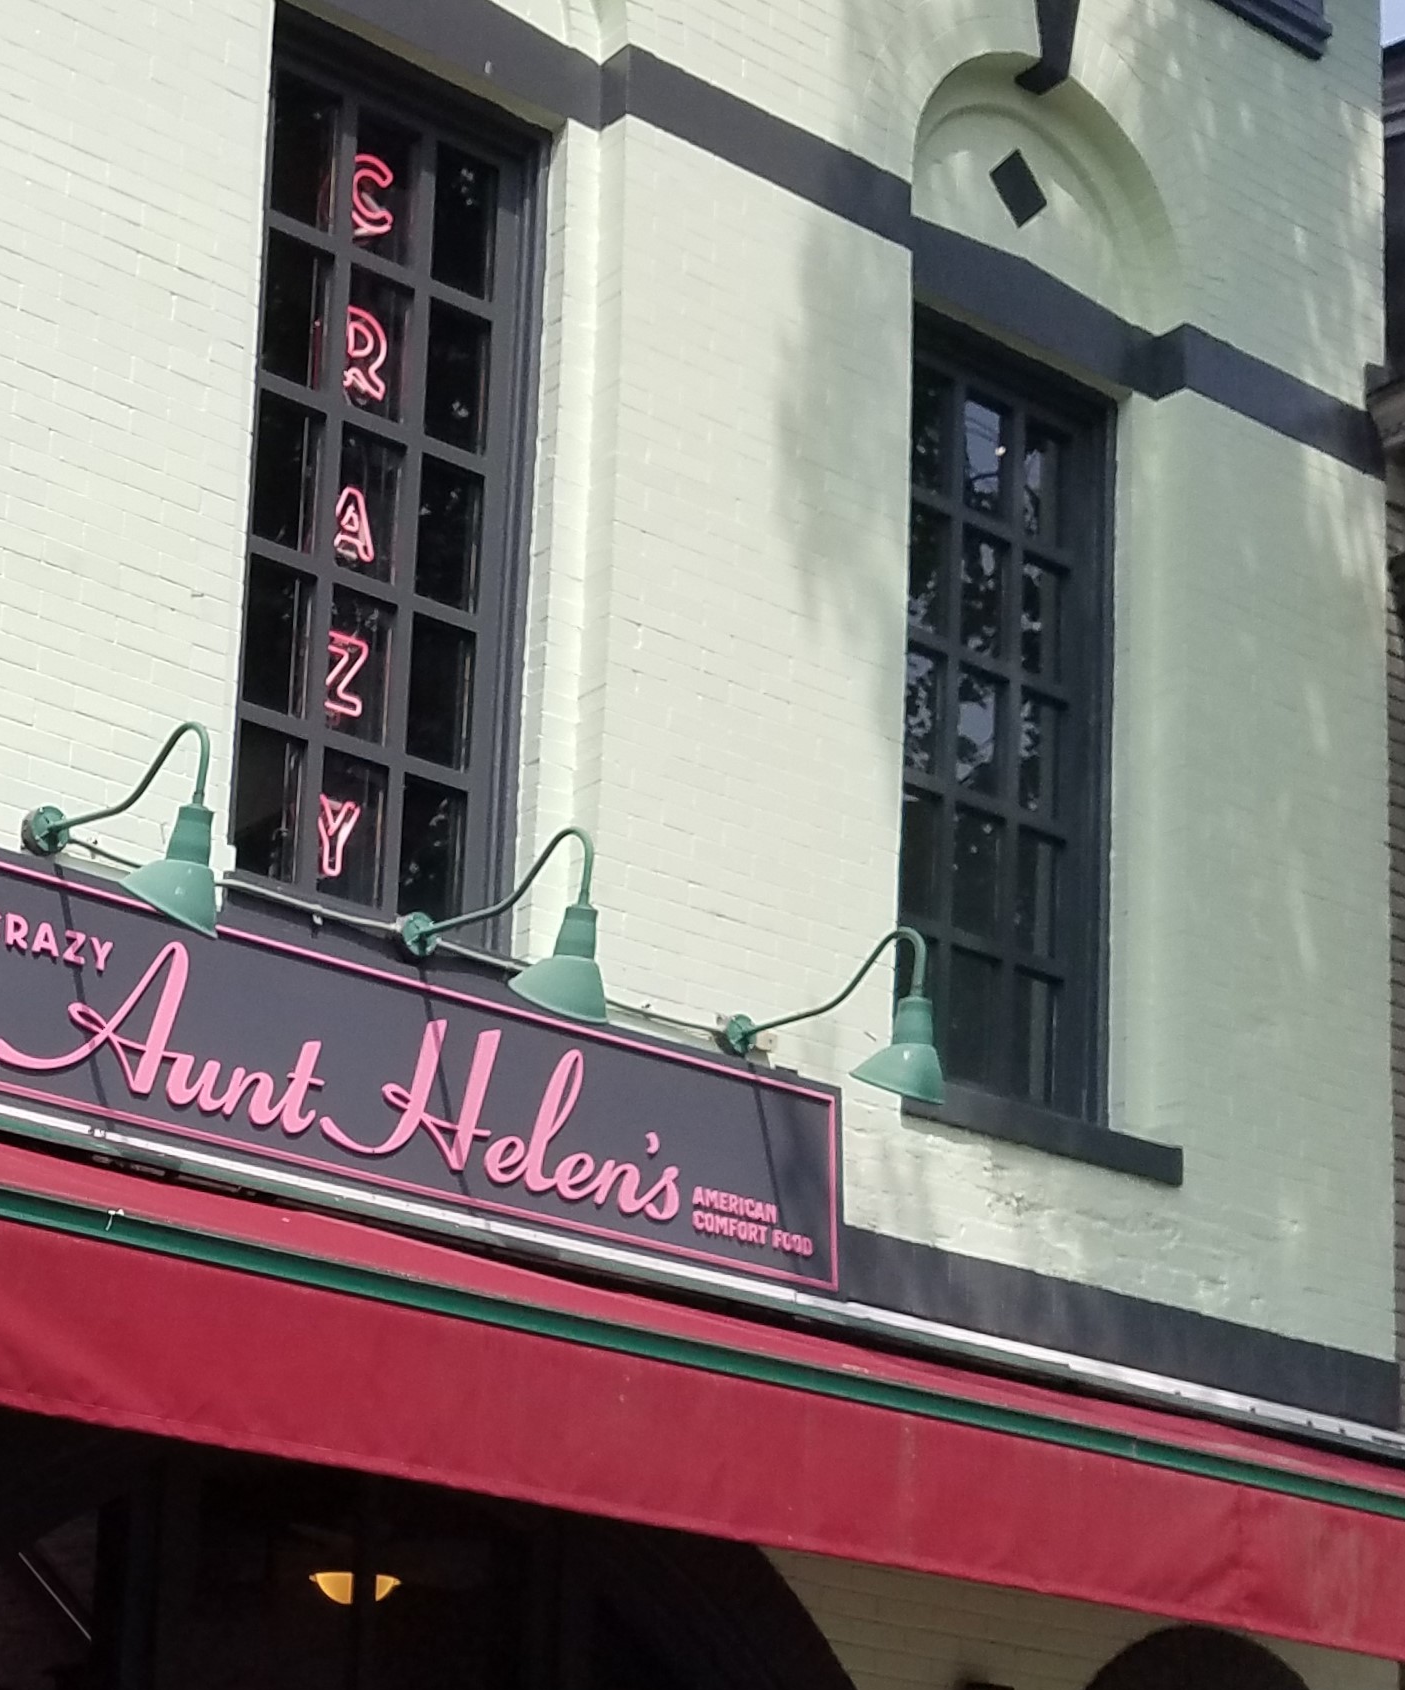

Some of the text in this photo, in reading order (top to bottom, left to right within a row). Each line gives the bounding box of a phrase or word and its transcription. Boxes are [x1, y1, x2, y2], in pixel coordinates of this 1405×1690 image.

[317, 153, 393, 877] CRAZY
[318, 1018, 681, 1222] Helen's
[692, 1186, 778, 1223] AMERICAN
[692, 1210, 813, 1256] COMFORT FOOD
